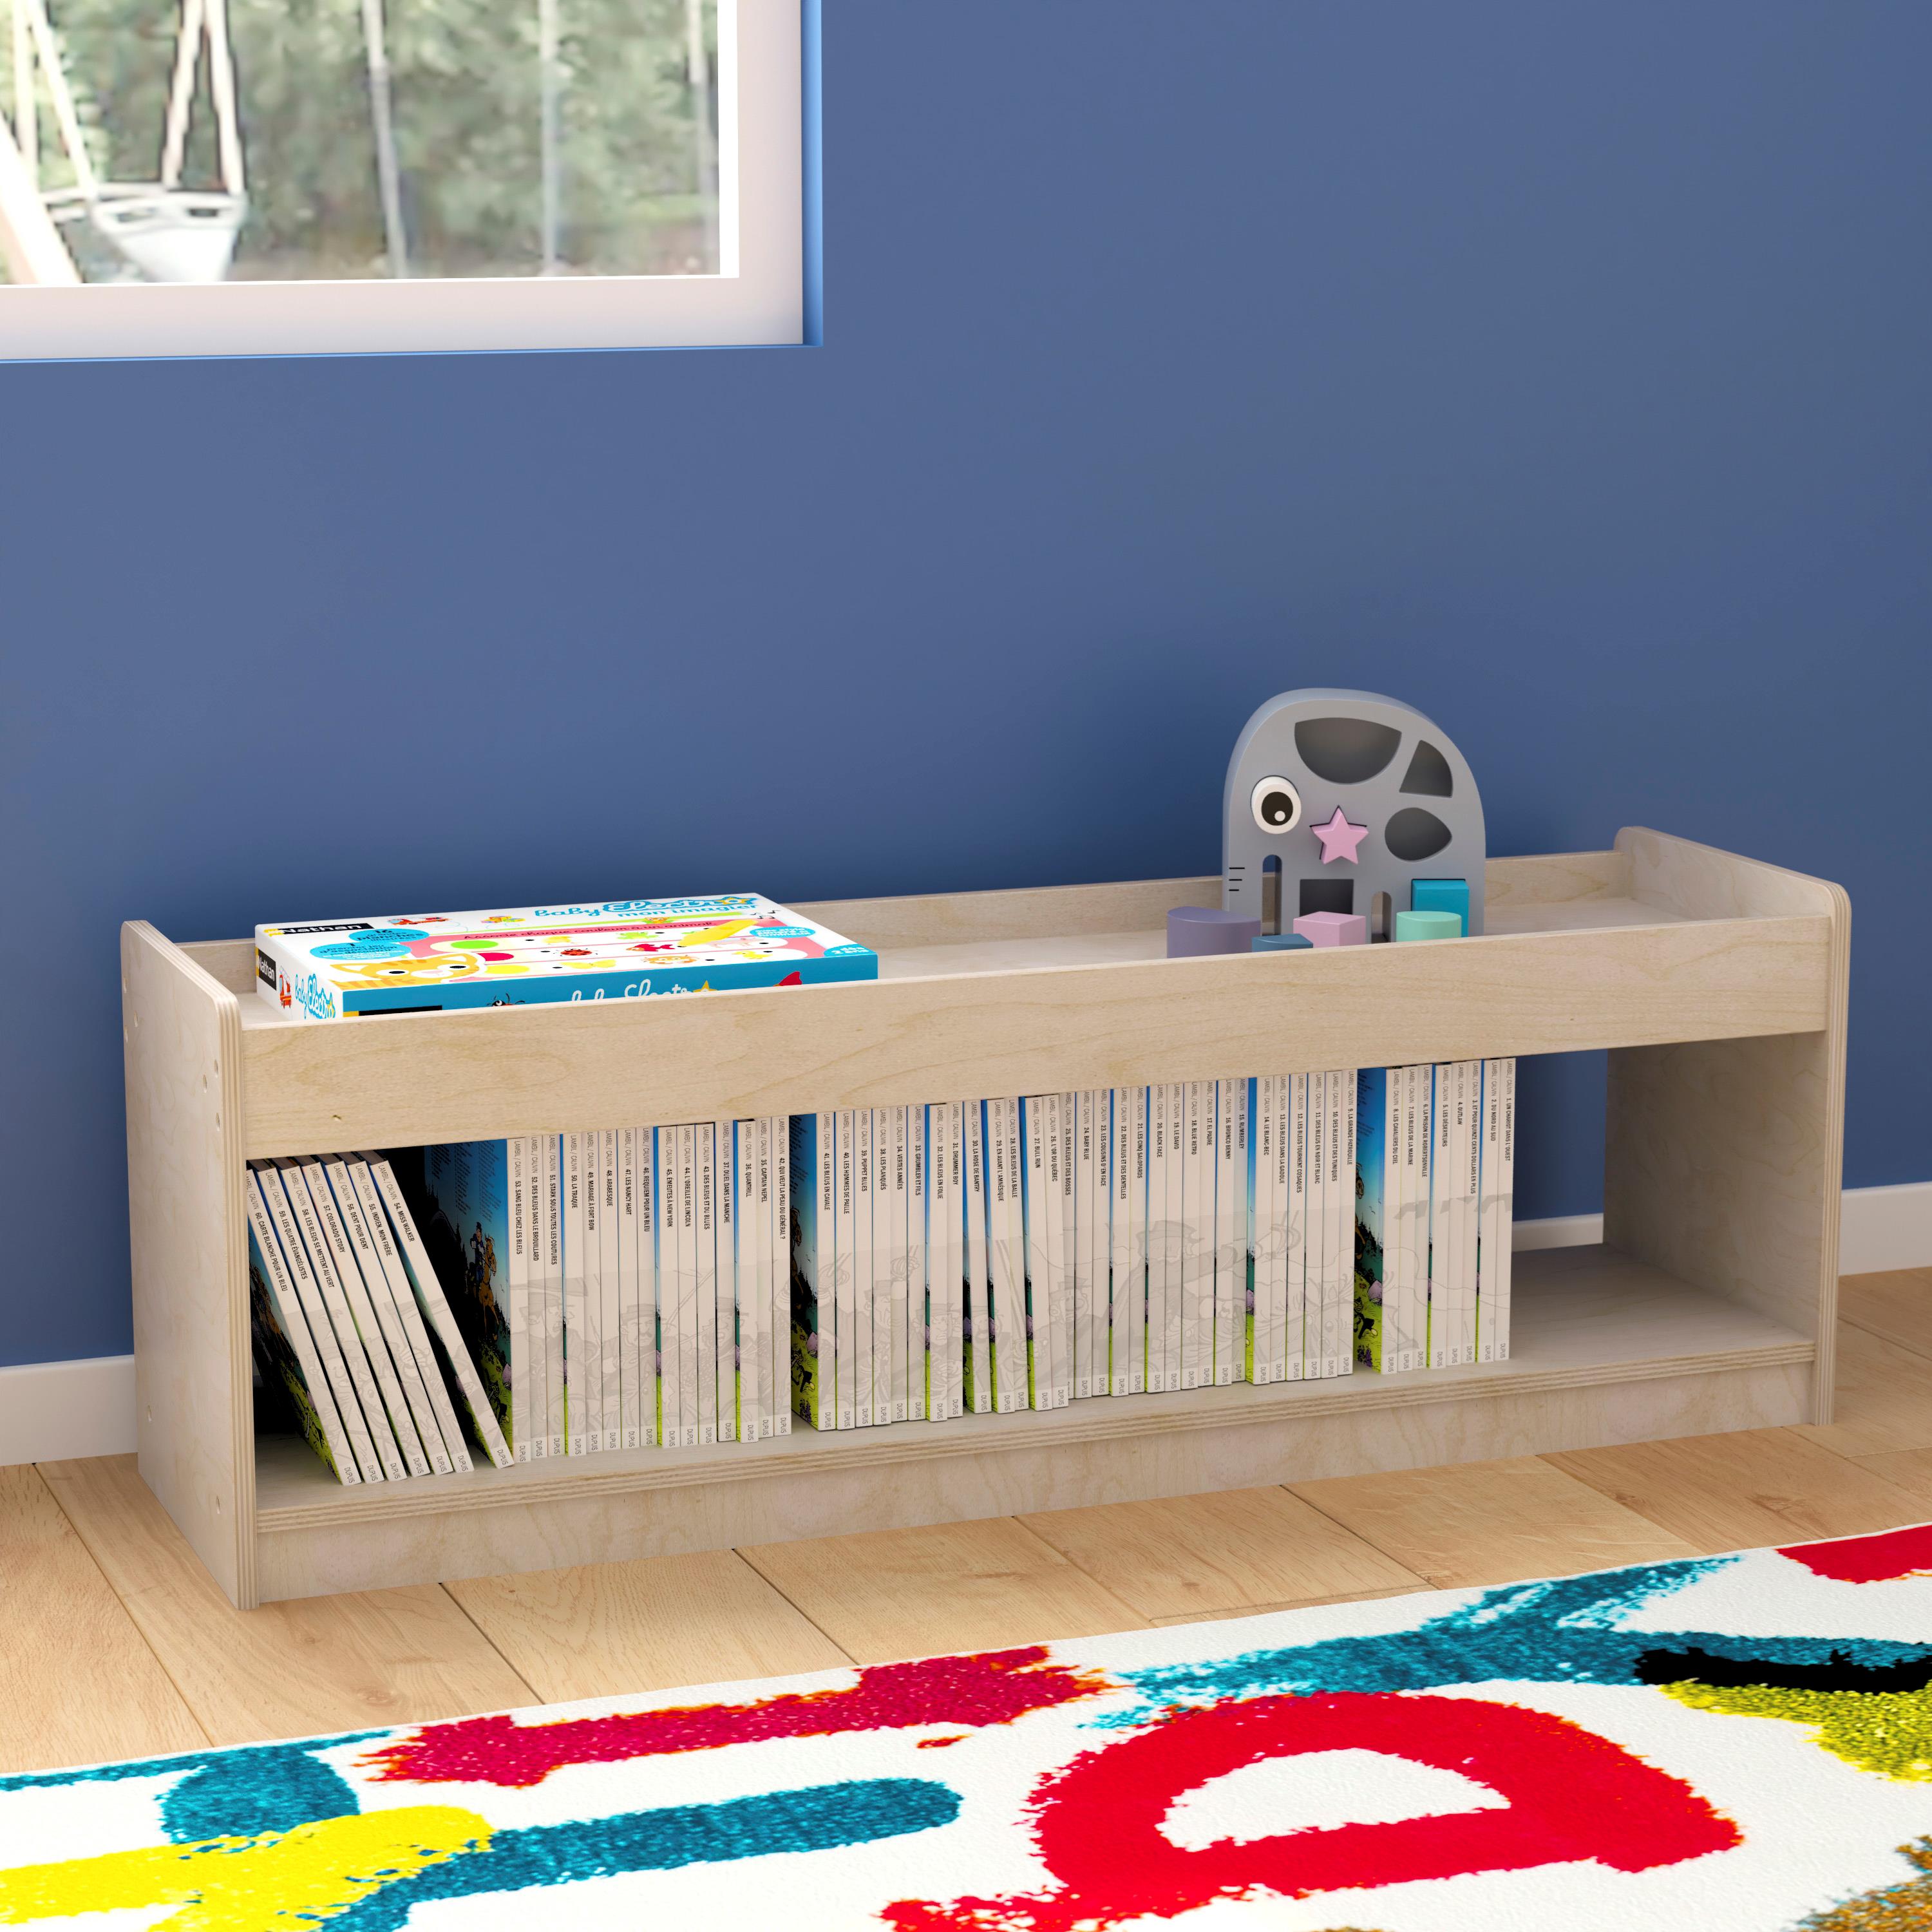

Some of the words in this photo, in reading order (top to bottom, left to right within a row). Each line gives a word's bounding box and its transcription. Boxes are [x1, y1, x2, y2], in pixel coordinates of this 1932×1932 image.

[535, 907, 601, 917] baby
[604, 897, 754, 912] Electro
[672, 904, 757, 913] imagier
[279, 925, 362, 934] Nathan
[258, 955, 276, 981] Nathan
[295, 974, 307, 1019] baby
[350, 1211, 359, 1223] DENT
[397, 1210, 406, 1223] MISS
[402, 1222, 414, 1242] WALKER
[326, 1213, 339, 1237] COLORADO
[335, 1238, 345, 1252] STORY
[354, 1224, 363, 1237] POUR
[372, 1211, 382, 1229] INDIEN,
[378, 1229, 386, 1241] MON
[383, 1241, 392, 1256] FRÈRE
[284, 1227, 296, 1246] QUATRE
[292, 1245, 307, 1279] ÉVANGÉLISTES
[359, 1237, 368, 1249] DENT
[258, 1220, 268, 1236] CARTE
[263, 1236, 276, 1258] BLANCHE
[271, 1258, 280, 1271] POUR
[278, 1278, 287, 1291] BLEU
[308, 1226, 318, 1242] BLEUS
[316, 1248, 327, 1268] METTENT
[325, 1275, 334, 1287] VERT
[367, 1464, 377, 1481] DUPUIS
[390, 1463, 401, 1479] DUPUIS
[457, 1455, 468, 1471] DUPUIS
